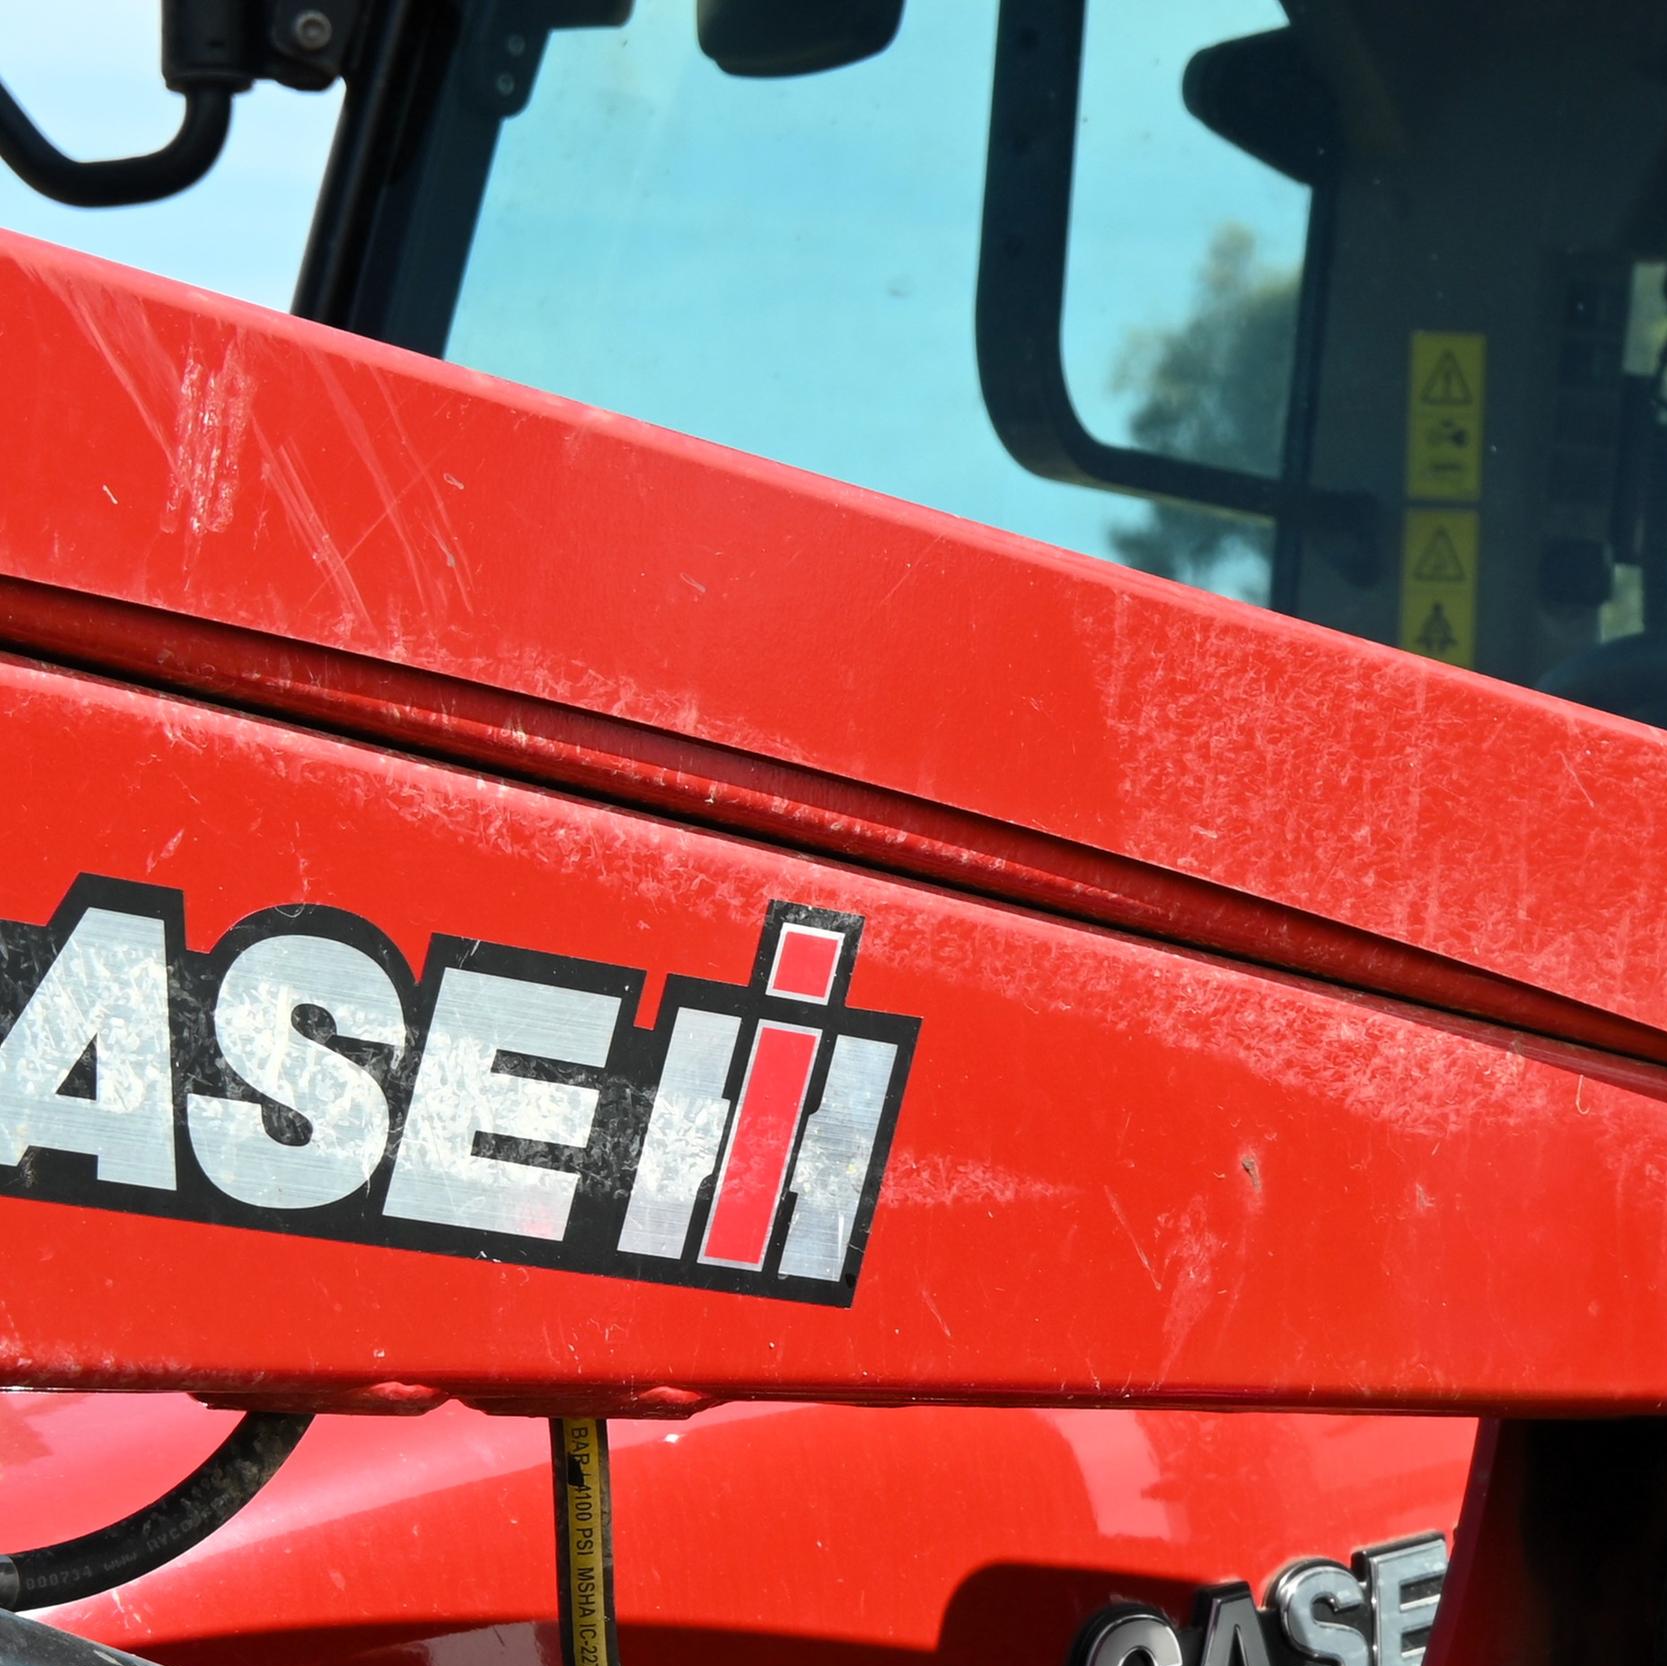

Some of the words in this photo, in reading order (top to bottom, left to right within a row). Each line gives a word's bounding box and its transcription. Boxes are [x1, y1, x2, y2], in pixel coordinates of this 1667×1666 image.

[0, 907, 623, 1241] ASE
[571, 1427, 590, 1465] BAR
[576, 1528, 593, 1556] PSI
[577, 1567, 596, 1618] MSHA
